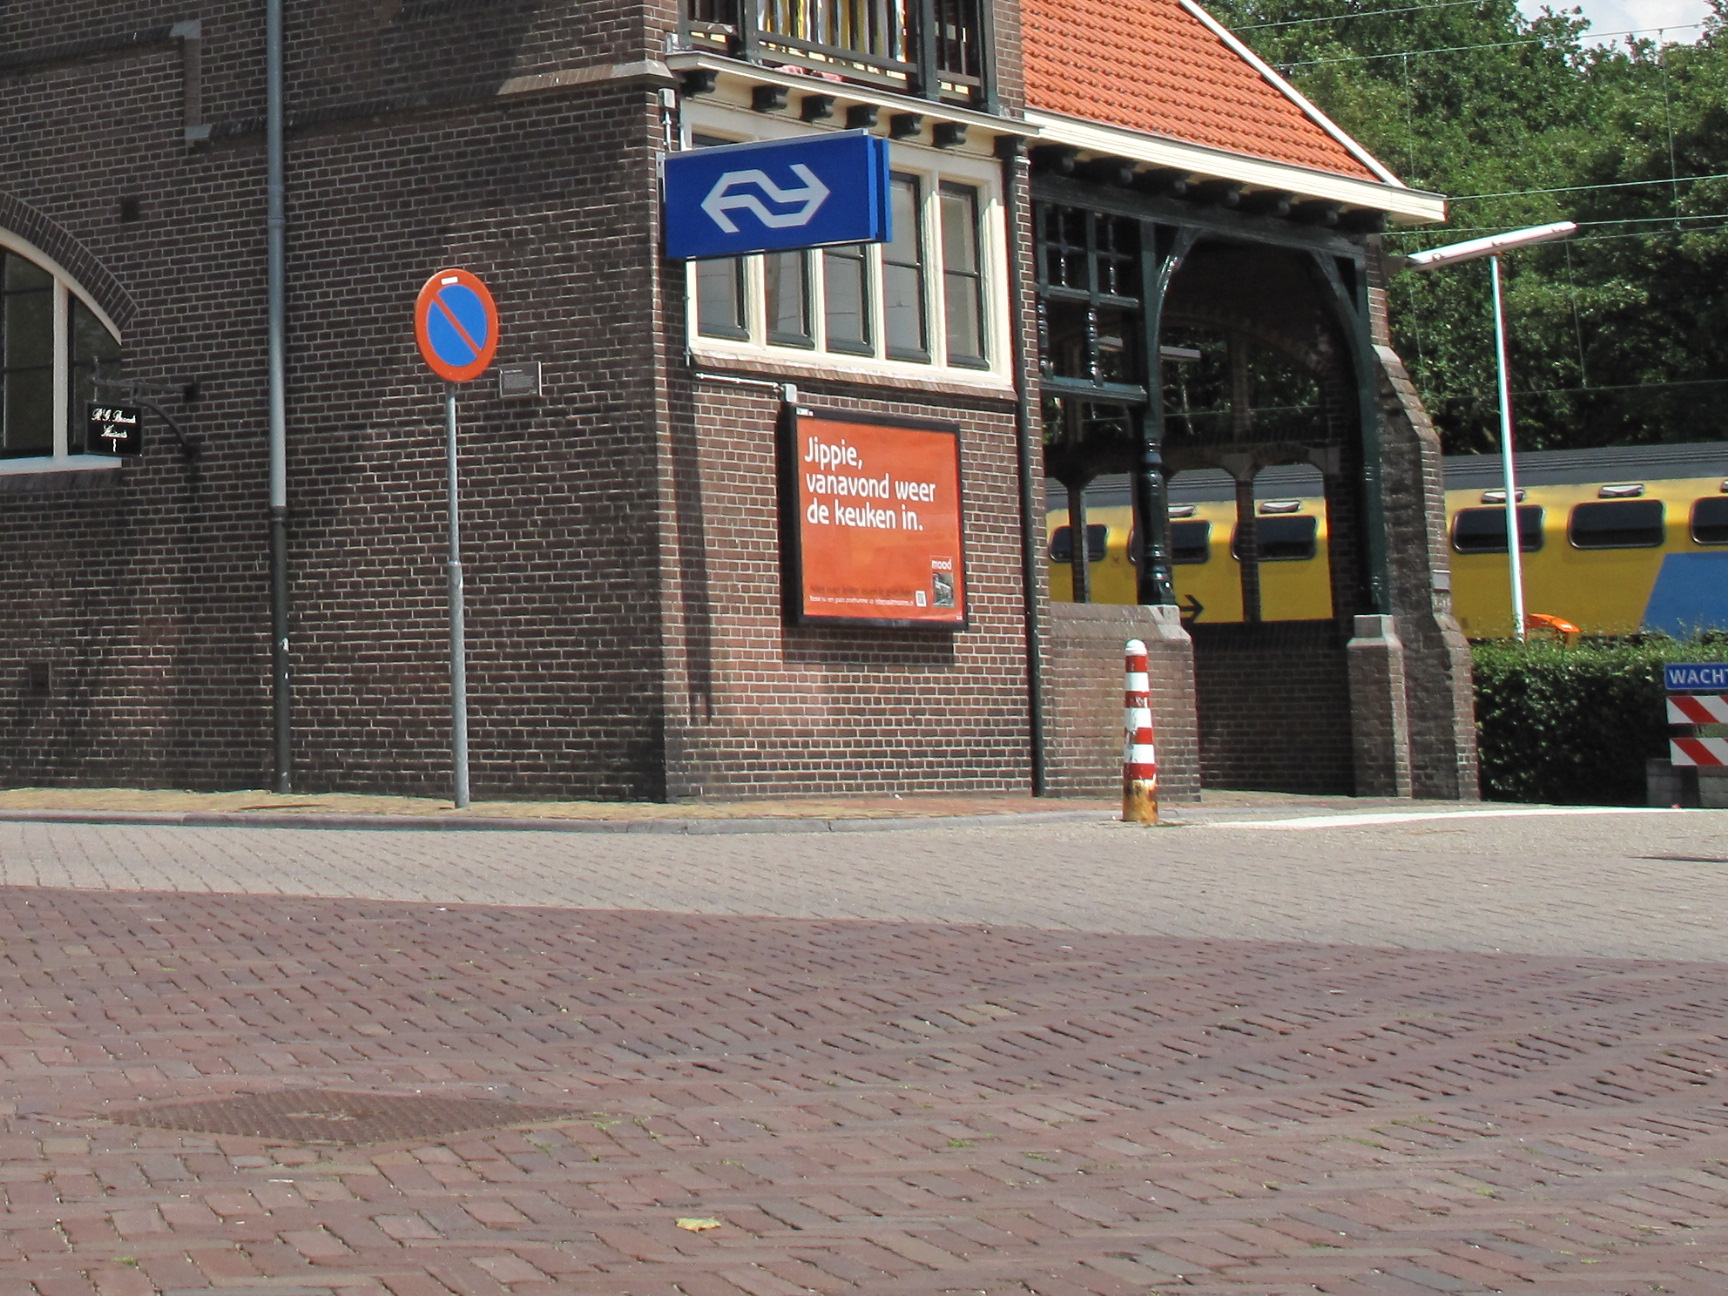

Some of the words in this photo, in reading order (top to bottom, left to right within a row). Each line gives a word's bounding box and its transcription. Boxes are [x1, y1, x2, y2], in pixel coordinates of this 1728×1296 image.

[804, 436, 863, 471] Jippie,
[806, 473, 890, 499] vanavond
[895, 480, 936, 502] weer
[806, 497, 830, 525] de
[834, 499, 896, 529] keuken
[901, 504, 924, 531] in.
